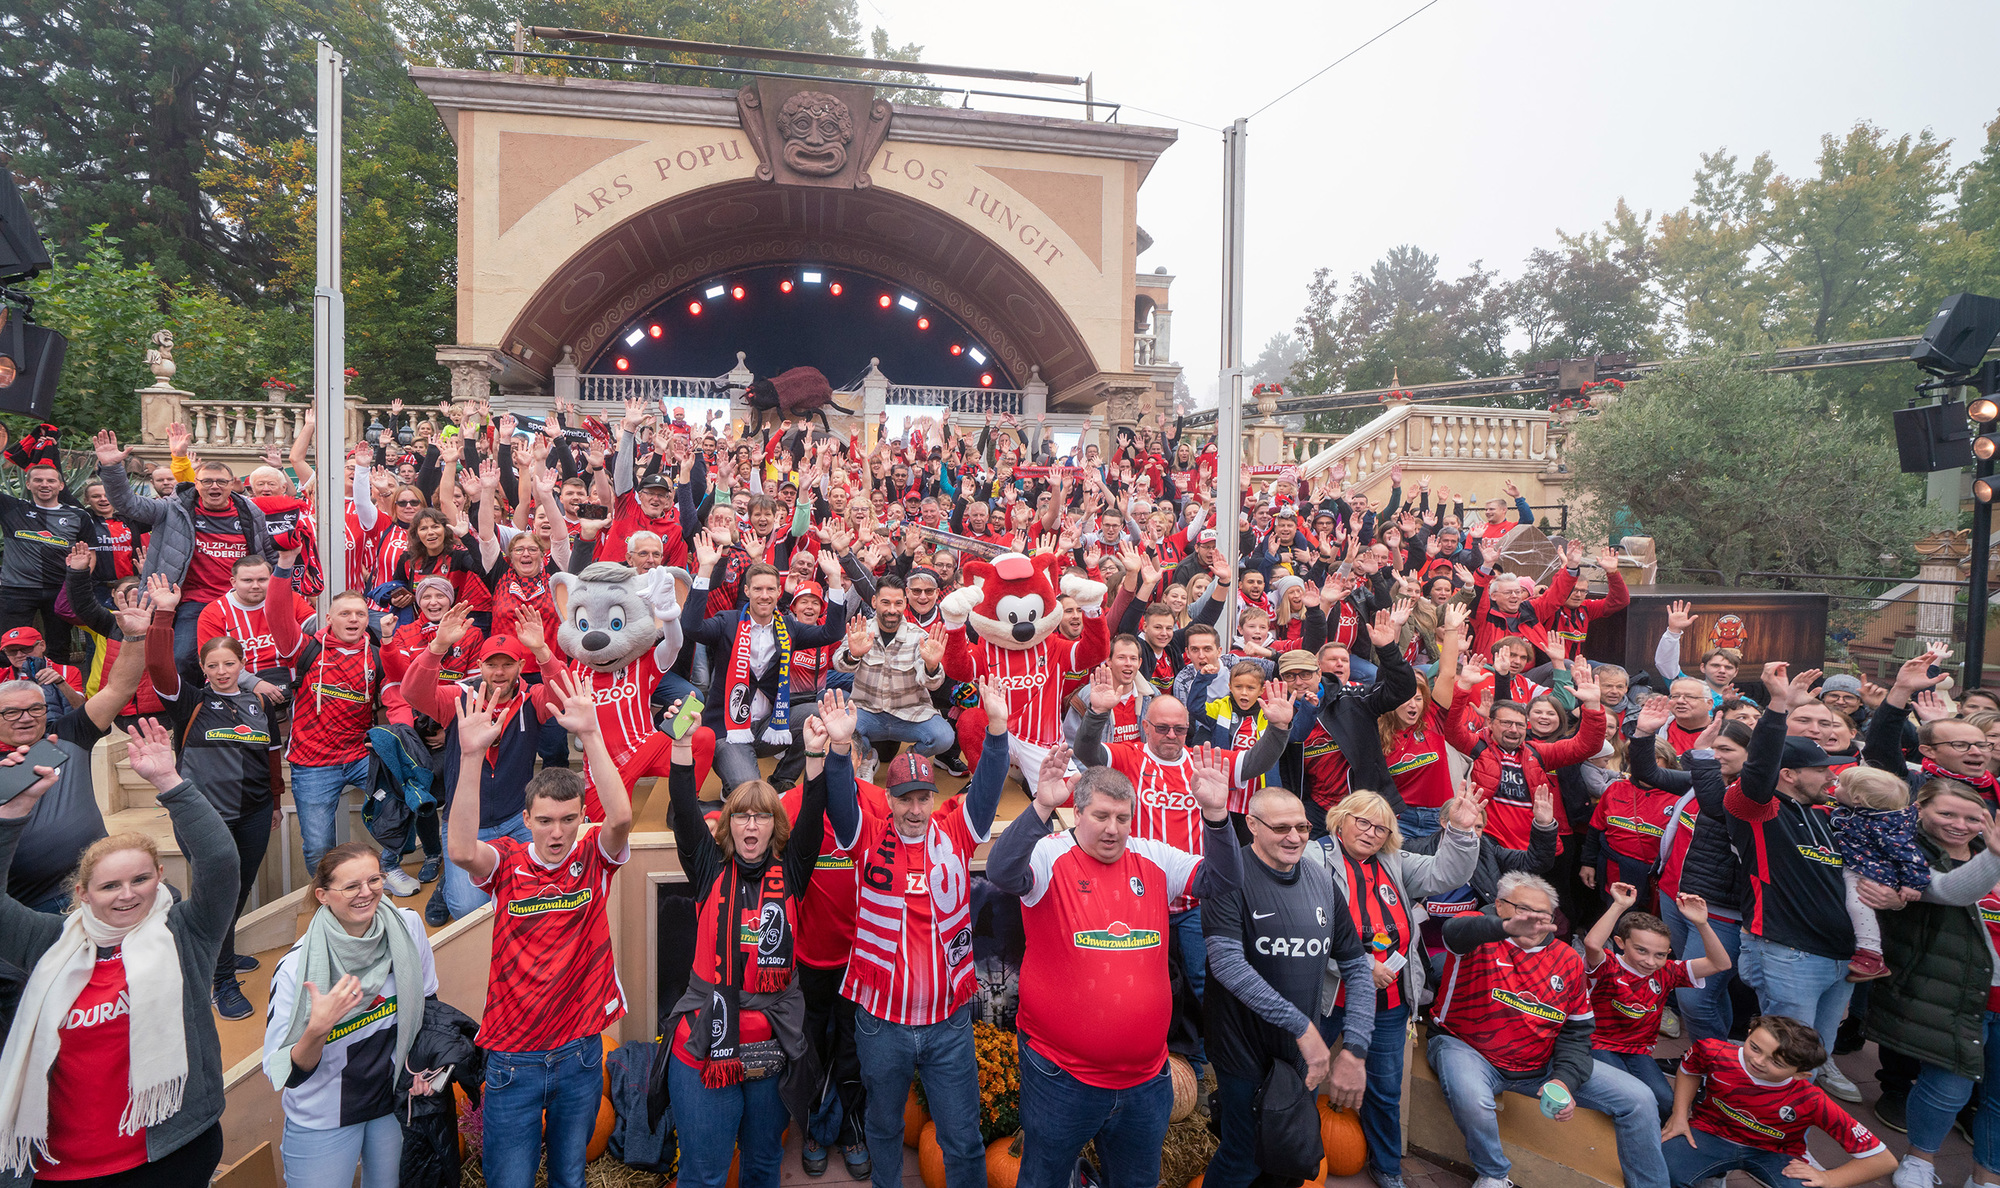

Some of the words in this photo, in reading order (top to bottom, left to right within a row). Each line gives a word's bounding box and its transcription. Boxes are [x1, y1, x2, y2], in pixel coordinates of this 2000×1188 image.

[573, 173, 634, 226] ARS
[652, 139, 744, 182] POPU
[880, 149, 949, 190] LOS
[966, 186, 1064, 267] IUNGIT
[736, 623, 751, 679] Stadion
[1001, 674, 1046, 690] AZOO
[1502, 770, 1524, 786] BIG
[1141, 790, 1199, 810] CAZO
[509, 889, 591, 914] Schwarzwaldmilch
[1428, 902, 1476, 913] Ehrmann
[1076, 933, 1160, 948] Schwarzwaldmilch
[1255, 936, 1331, 957] CAZOO
